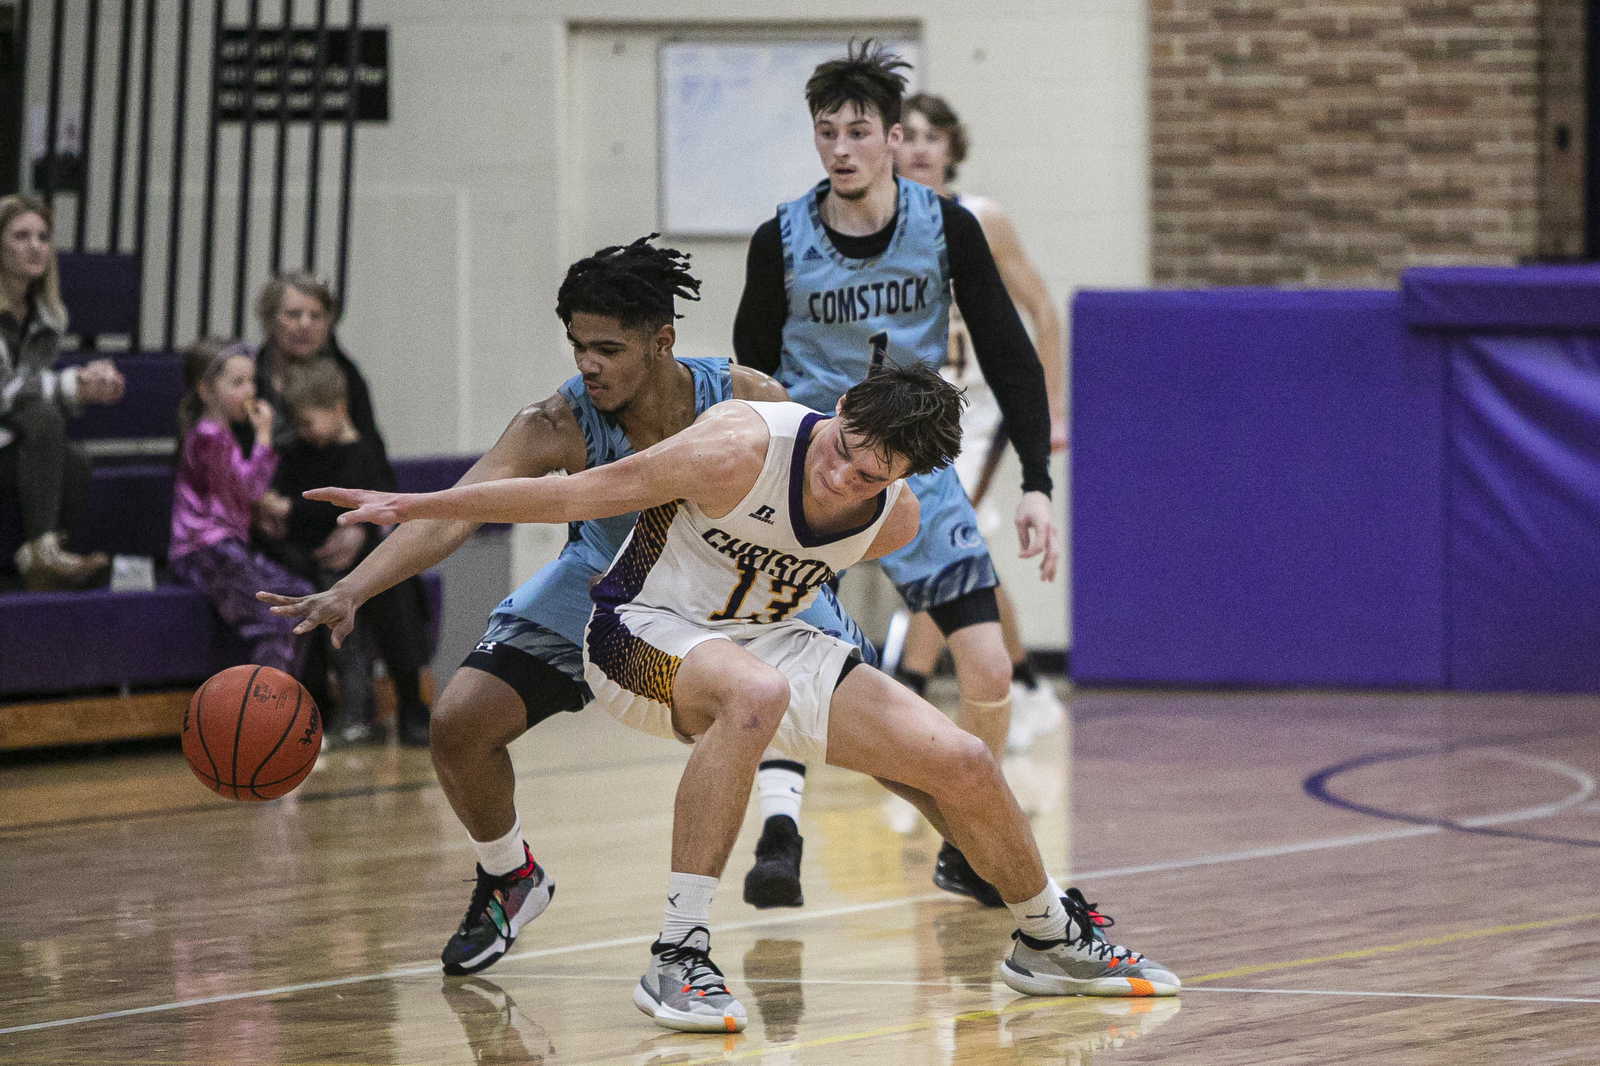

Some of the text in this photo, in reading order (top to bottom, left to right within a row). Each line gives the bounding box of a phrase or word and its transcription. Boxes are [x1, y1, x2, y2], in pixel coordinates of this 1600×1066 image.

[808, 276, 929, 325] COMSTOCK
[867, 330, 889, 381] 1
[706, 557, 810, 624] 13
